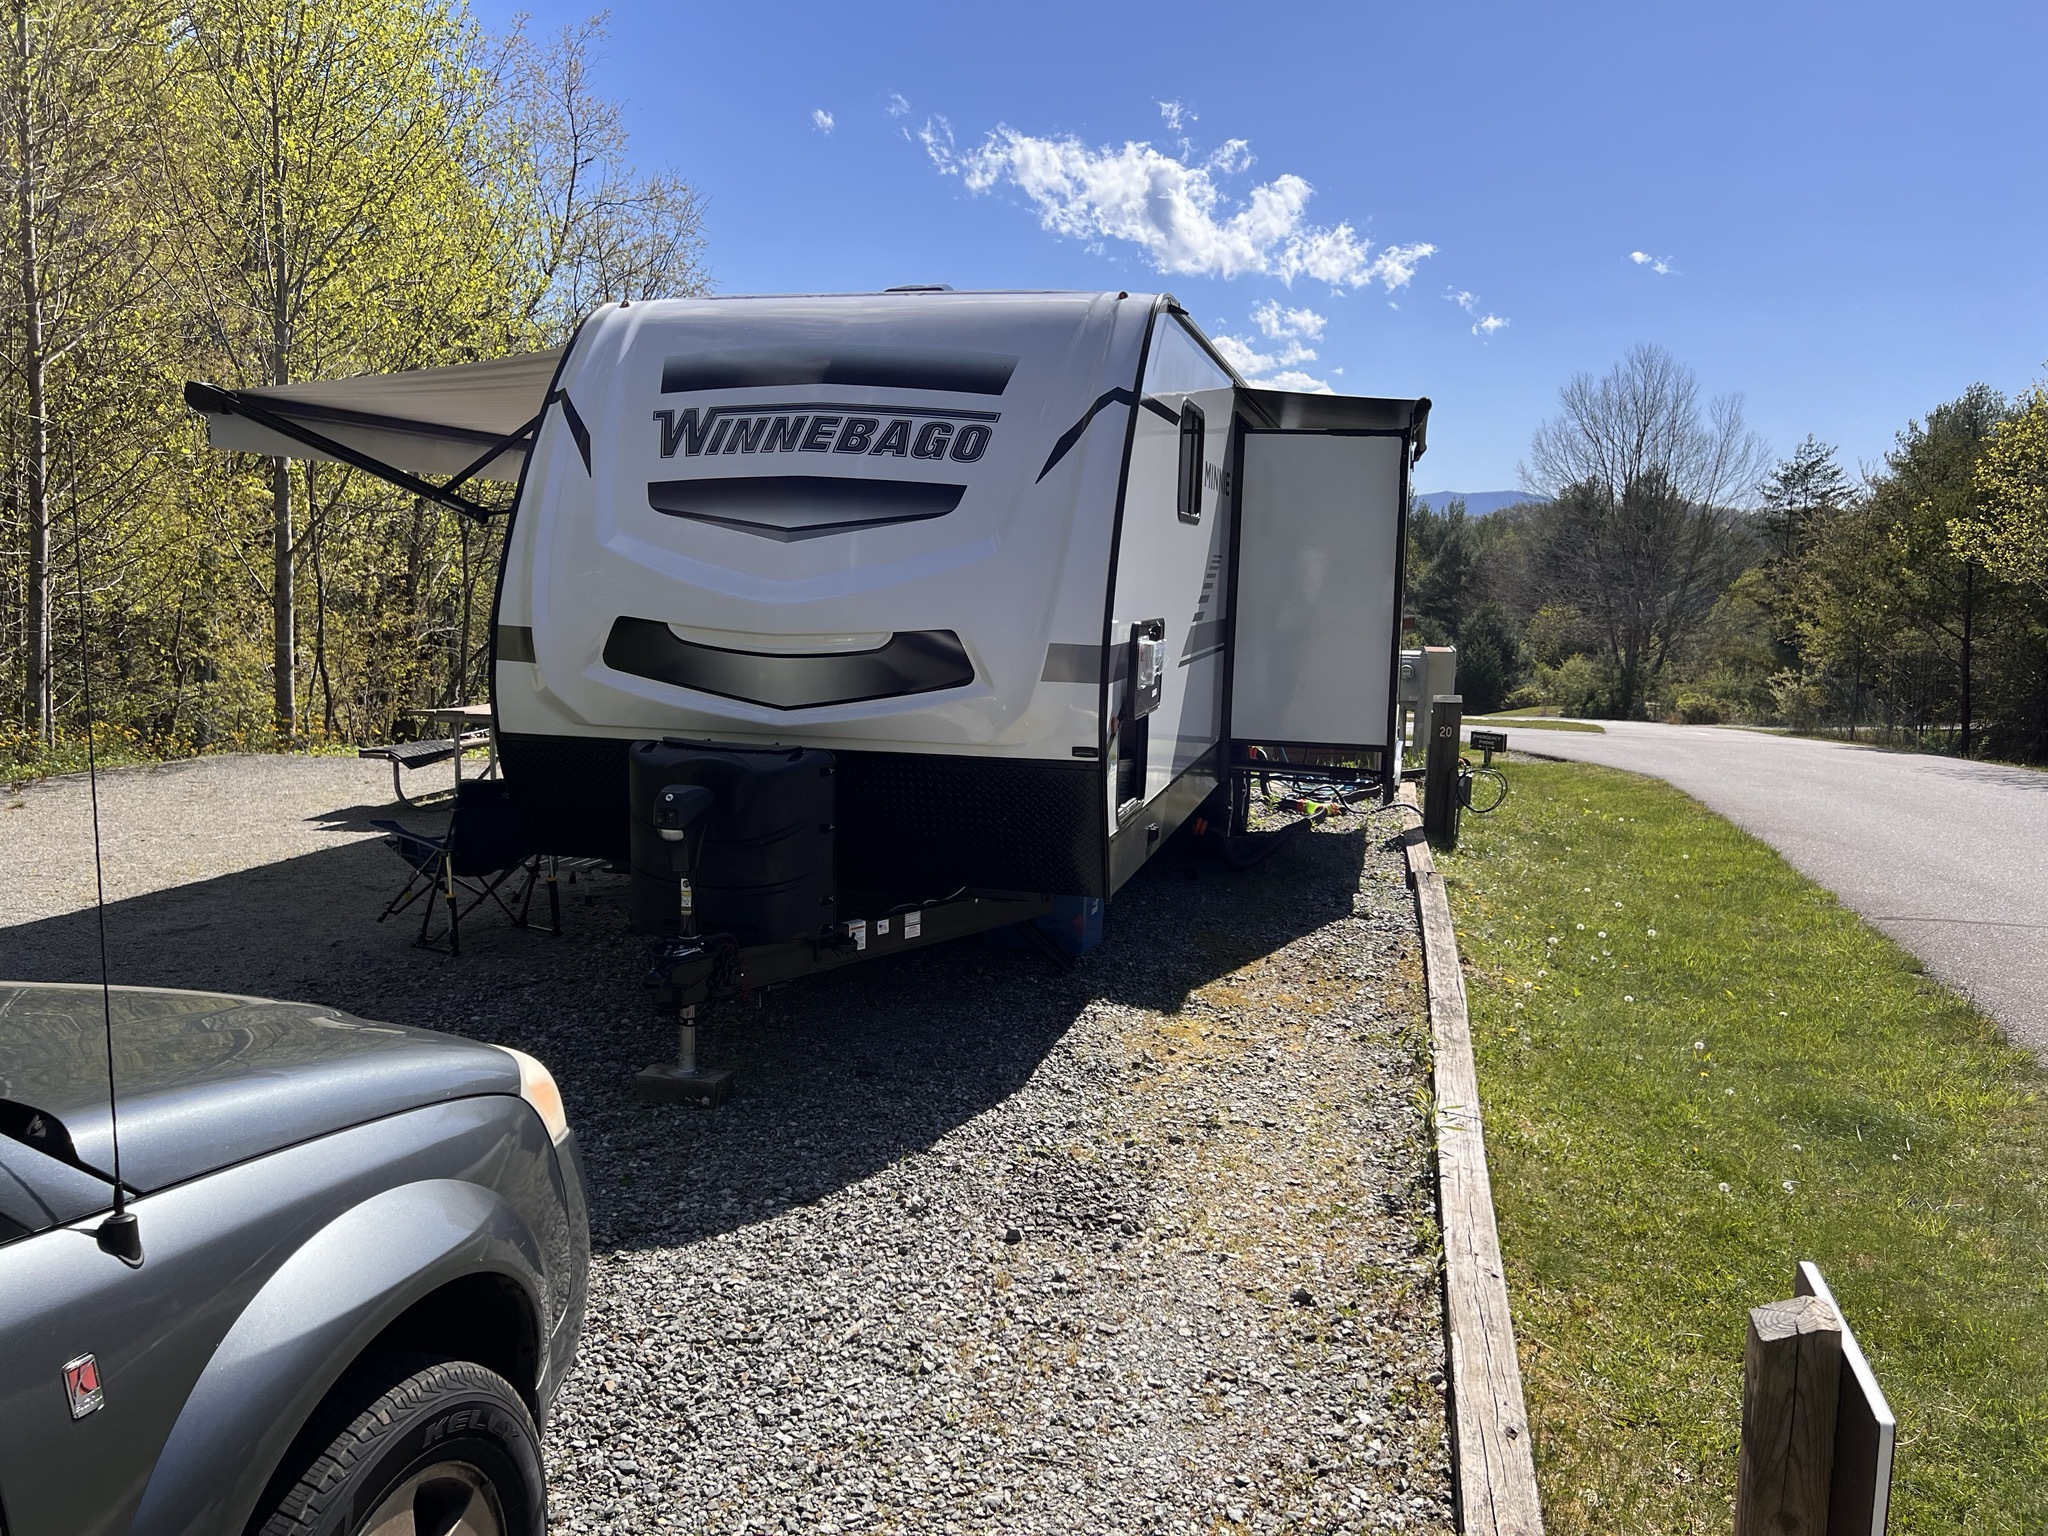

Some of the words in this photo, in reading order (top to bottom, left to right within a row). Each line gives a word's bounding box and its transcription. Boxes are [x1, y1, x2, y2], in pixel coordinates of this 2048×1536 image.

[653, 402, 1001, 463] WINNEBAGO
[1204, 461, 1230, 497] MINNIE
[1439, 726, 1453, 738] 20
[422, 1409, 520, 1448] KELLY
